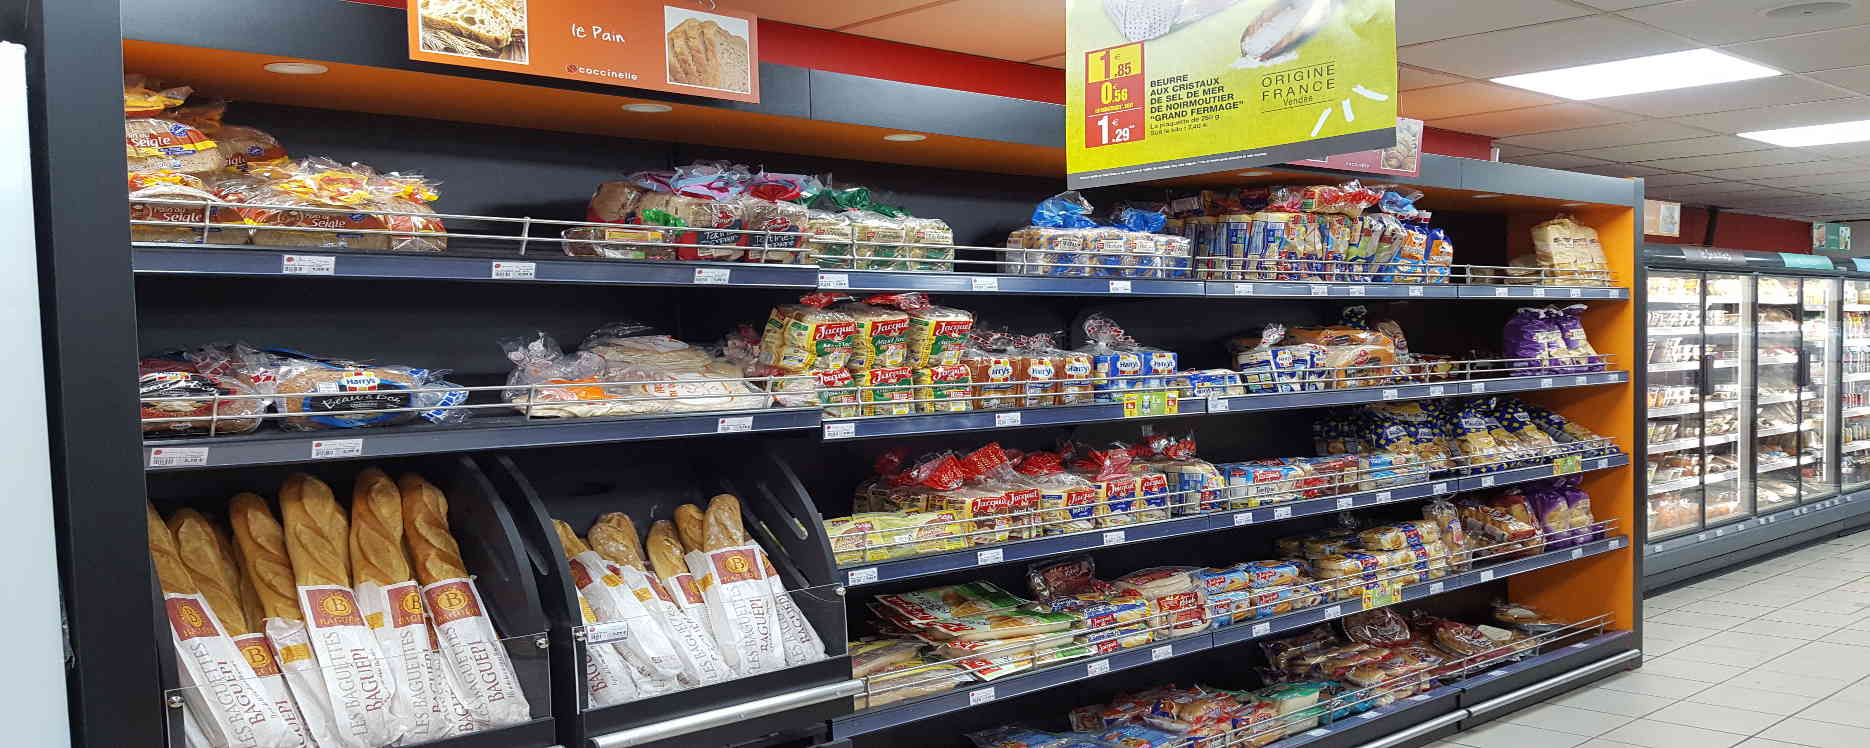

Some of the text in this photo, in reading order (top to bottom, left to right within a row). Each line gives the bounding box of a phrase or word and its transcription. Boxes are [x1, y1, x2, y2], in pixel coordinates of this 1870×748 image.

[571, 23, 625, 42] le Pain
[578, 66, 639, 80] coccinelle
[1150, 74, 1189, 88] BEURRE
[1262, 64, 1336, 88] ORIGINE
[1150, 77, 1220, 97] AUX CRISTAUX
[1150, 85, 1225, 105] DE SEL DE MER
[1262, 78, 1336, 102] FRANCE
[1150, 104, 1164, 114] DE
[1166, 93, 1235, 112] NOIRMOUTIER
[346, 378, 376, 386] Harrys
[973, 498, 1004, 512] Jacqu
[323, 631, 361, 710] BAGUETTES
